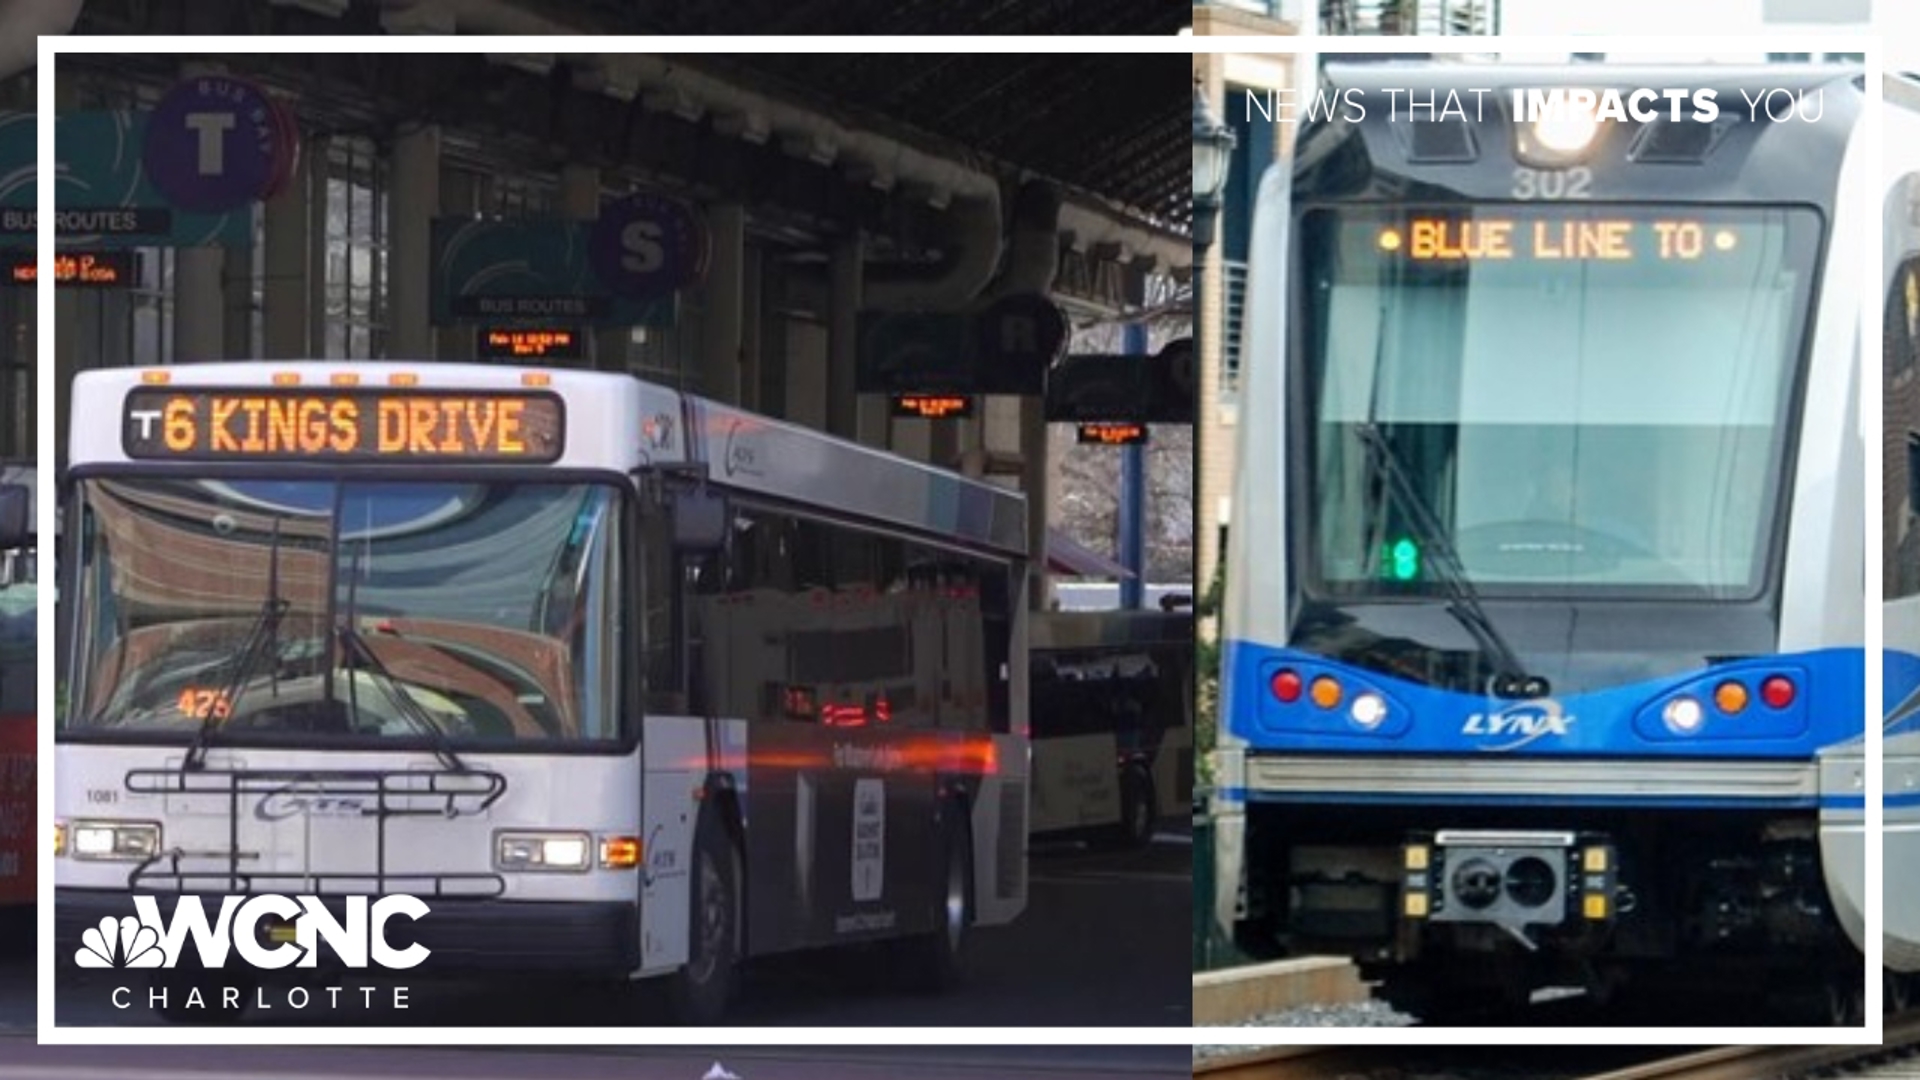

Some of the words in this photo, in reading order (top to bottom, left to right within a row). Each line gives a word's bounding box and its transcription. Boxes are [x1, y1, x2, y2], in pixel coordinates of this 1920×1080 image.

[184, 112, 236, 175] T
[1511, 166, 1593, 200] 302
[55, 211, 138, 231] ROUTES
[620, 220, 665, 273] S
[1411, 221, 1513, 259] BLUE
[1535, 222, 1633, 258] LINE
[1654, 222, 1703, 258] TO
[479, 298, 513, 313] BUS
[517, 298, 587, 313] ROUTES
[164, 397, 196, 452] 6
[210, 398, 359, 453] KINGS
[378, 399, 525, 453] DRIVE
[1462, 713, 1576, 736] LYNX
